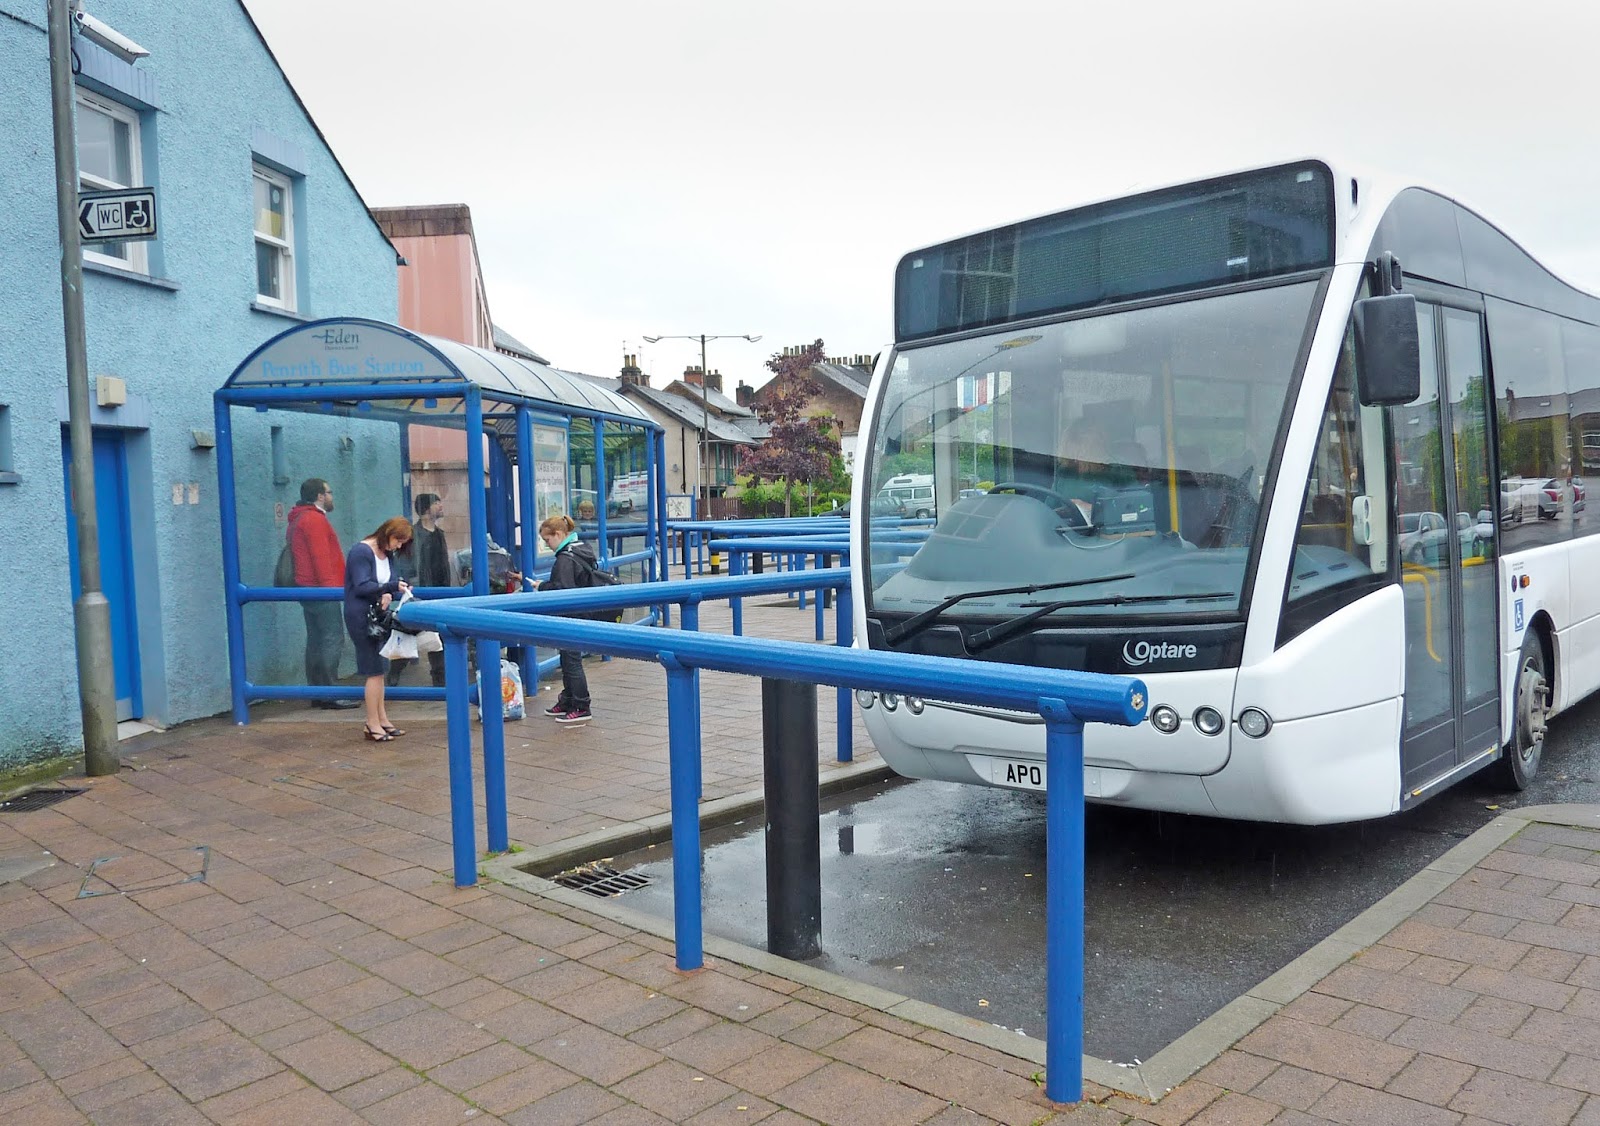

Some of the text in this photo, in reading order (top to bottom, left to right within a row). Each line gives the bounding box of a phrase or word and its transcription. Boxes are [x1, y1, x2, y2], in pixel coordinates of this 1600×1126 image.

[99, 208, 120, 225] WC
[325, 329, 359, 344] Eden
[262, 356, 424, 378] Penrith Bus Station
[1135, 641, 1197, 663] Optare
